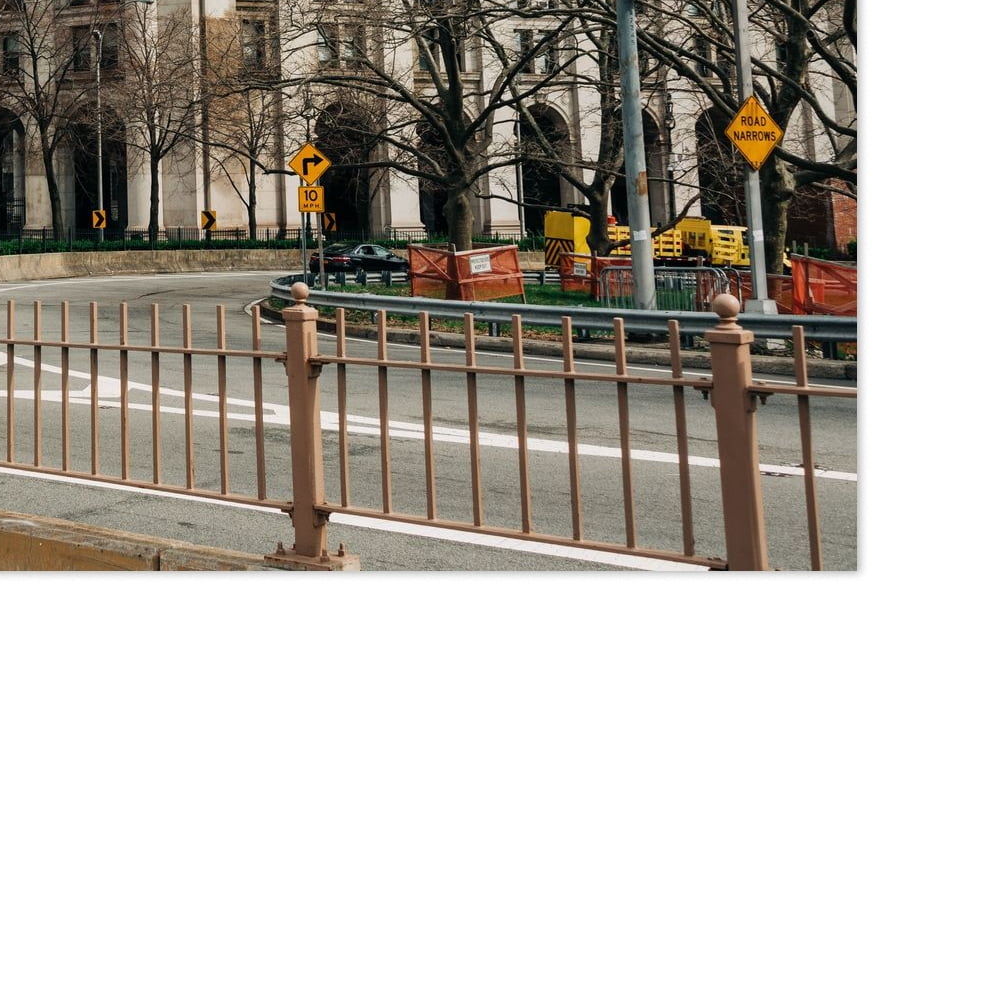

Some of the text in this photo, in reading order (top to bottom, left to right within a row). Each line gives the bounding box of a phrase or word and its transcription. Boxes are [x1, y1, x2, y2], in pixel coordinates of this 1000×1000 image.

[740, 115, 767, 127] ROAD
[733, 130, 777, 142] NARROWS
[303, 189, 318, 202] 10
